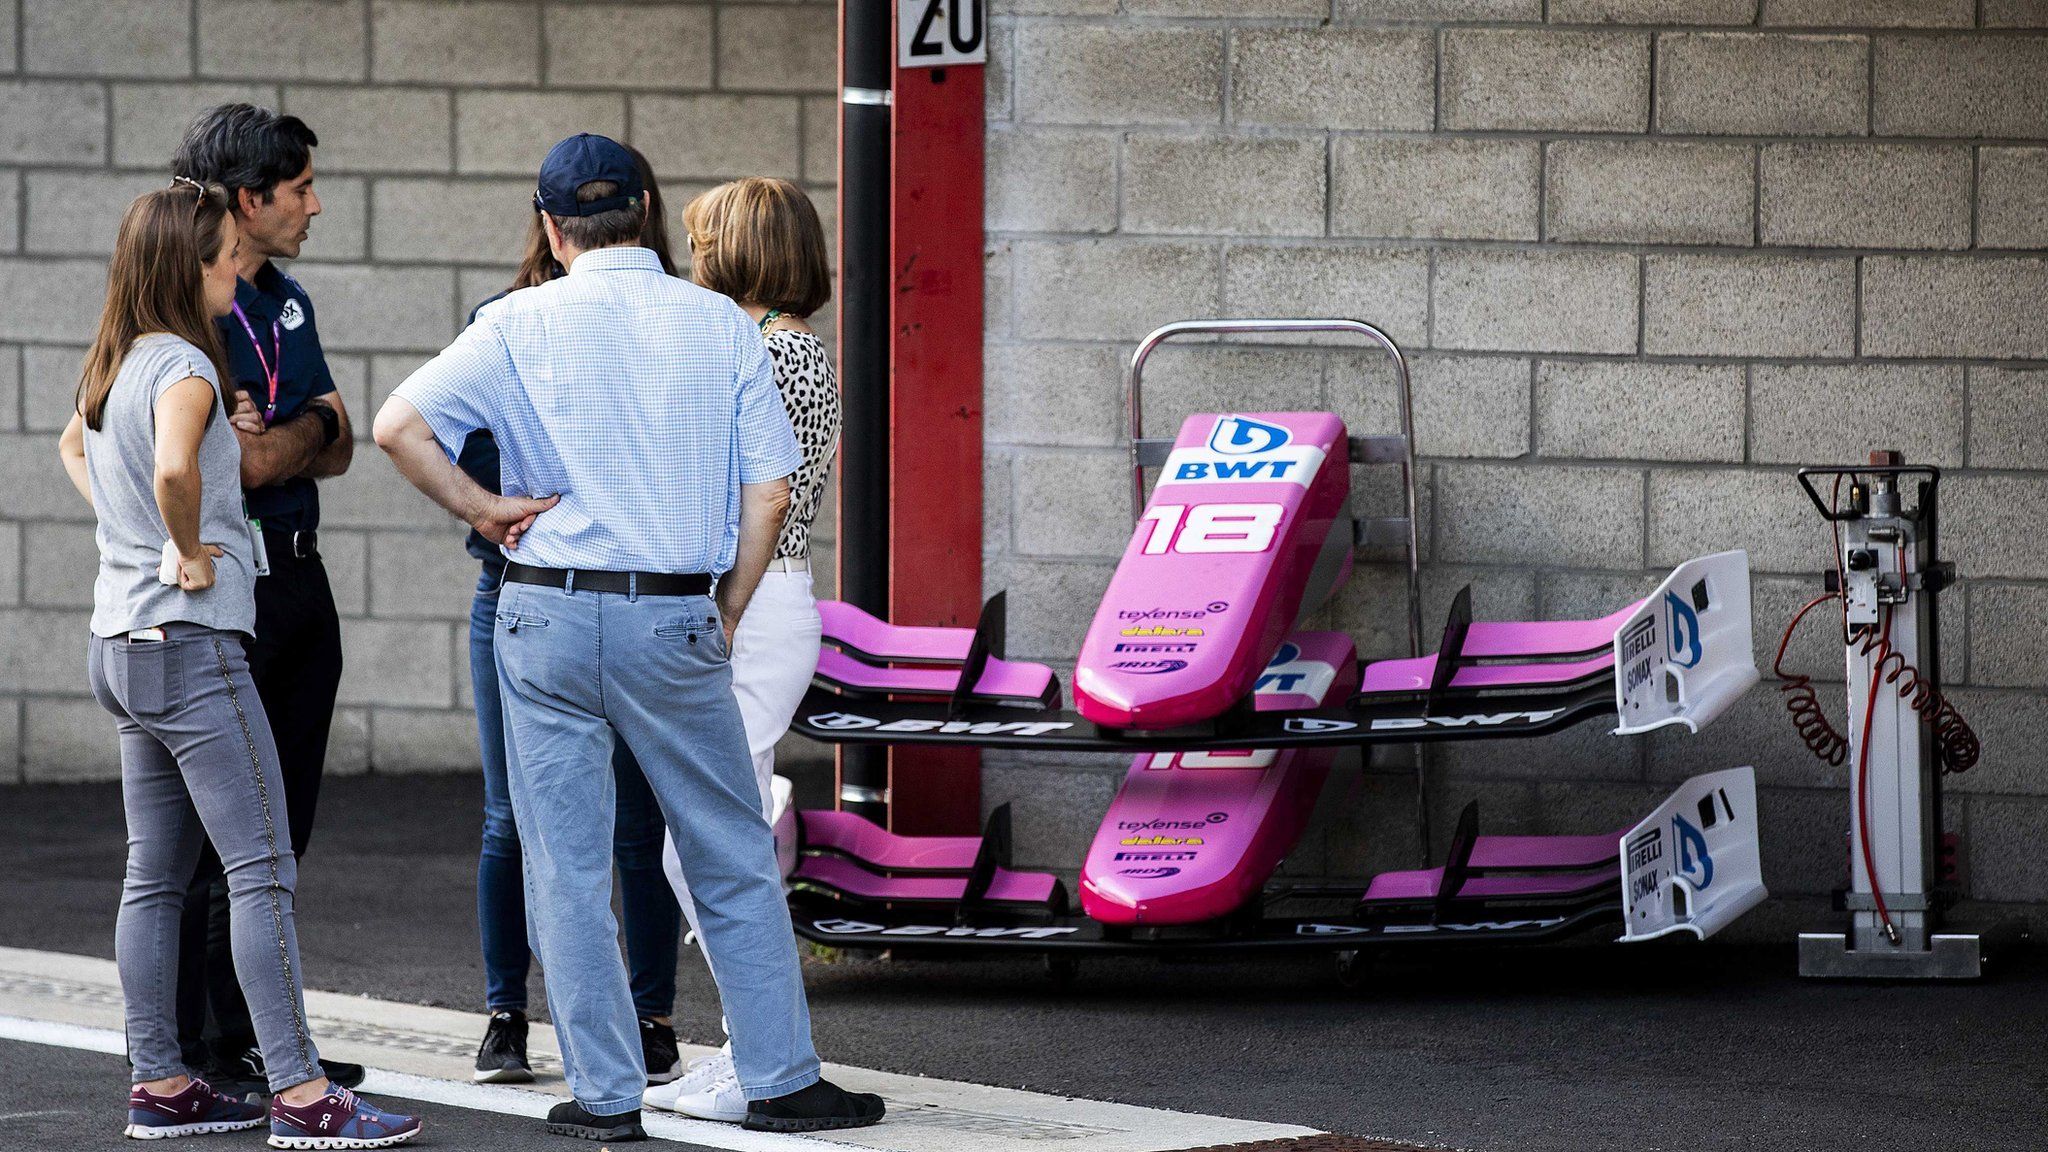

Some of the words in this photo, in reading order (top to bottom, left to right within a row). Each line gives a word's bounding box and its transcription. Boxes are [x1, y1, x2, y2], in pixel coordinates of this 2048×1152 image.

[910, 0, 982, 56] 20
[1175, 461, 1297, 480] BWT
[1141, 502, 1286, 555] 18
[1119, 607, 1206, 624] texense
[1114, 643, 1198, 653] PIRELLI
[1621, 613, 1656, 666] PIRELLI
[875, 718, 1074, 736] BWT
[1371, 706, 1566, 730] BWT
[1118, 817, 1206, 834] texense
[1113, 852, 1198, 861] PIRELLI
[1627, 826, 1662, 876] PIRELLI
[880, 924, 1079, 939] BWT
[1383, 915, 1566, 934] BWT
